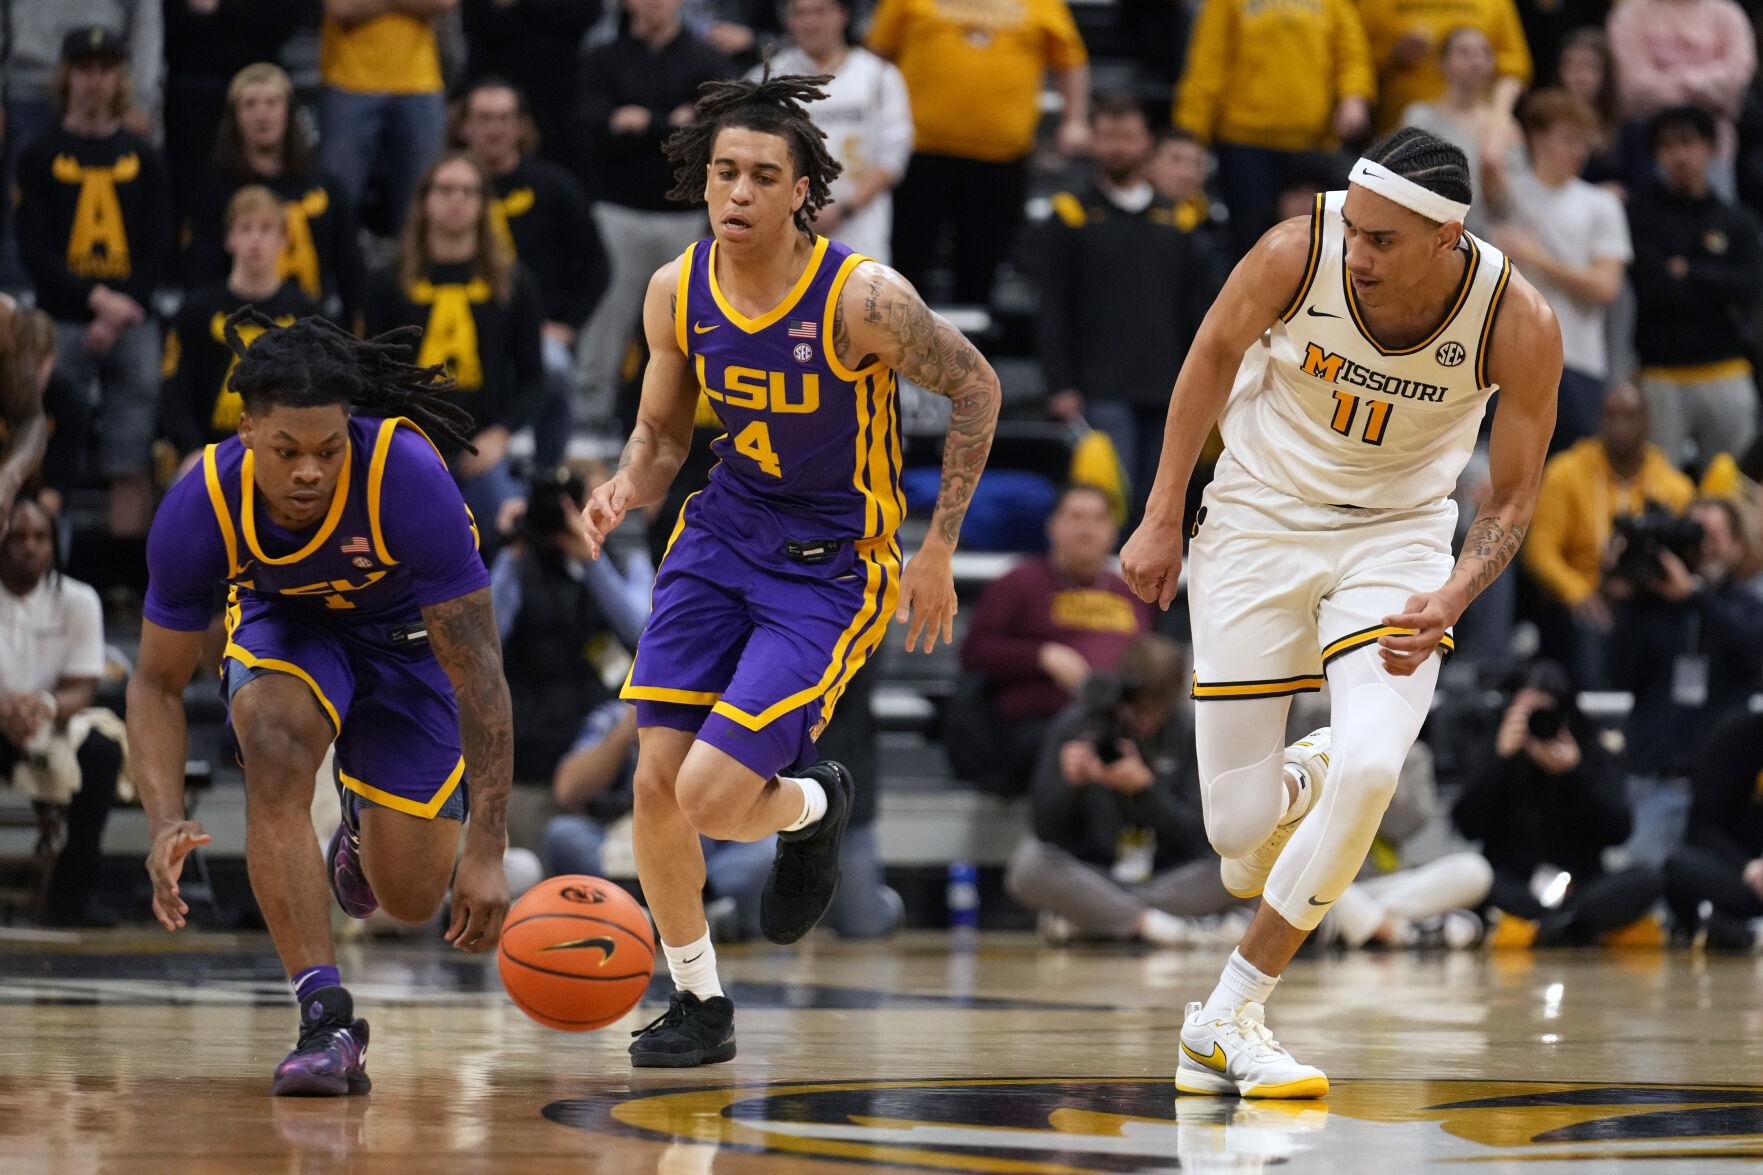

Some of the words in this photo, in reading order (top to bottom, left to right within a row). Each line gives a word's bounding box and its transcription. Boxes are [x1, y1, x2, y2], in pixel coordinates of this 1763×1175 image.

[795, 344, 812, 362] SEC
[1300, 341, 1449, 403] MISSOURI
[1436, 341, 1466, 367] SEC
[694, 353, 820, 414] LSU
[1331, 390, 1394, 446] 11
[734, 420, 783, 479] 4
